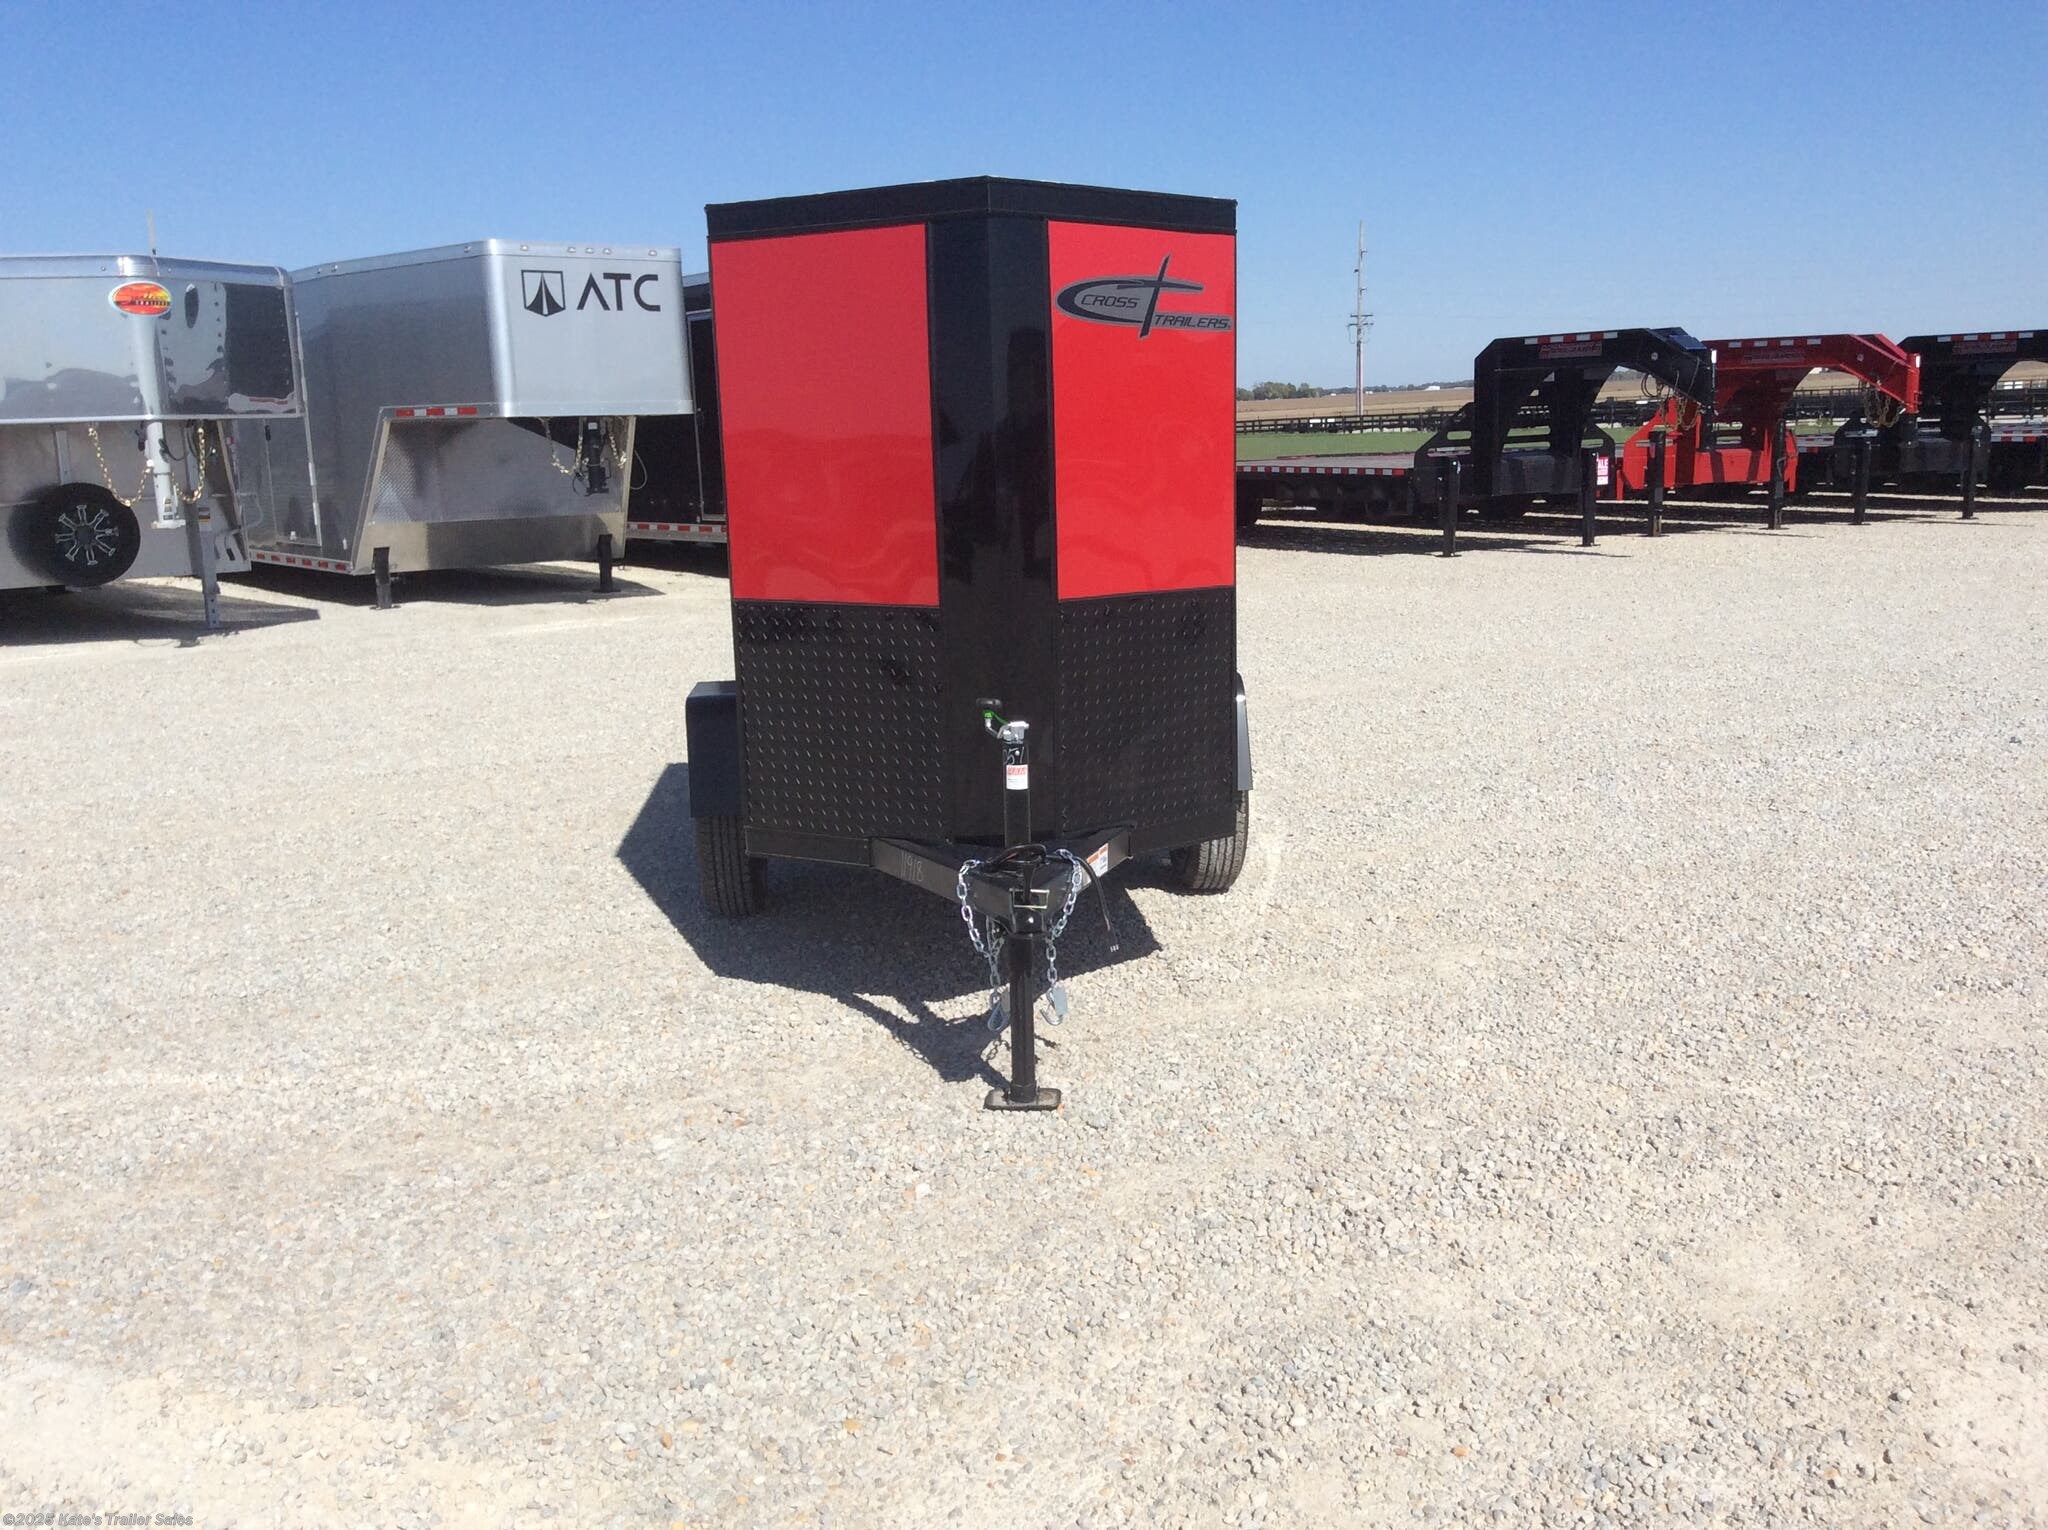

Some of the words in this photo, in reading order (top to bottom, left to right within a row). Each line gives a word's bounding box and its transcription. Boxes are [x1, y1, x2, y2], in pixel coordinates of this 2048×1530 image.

[576, 272, 661, 312] ATC
[1081, 294, 1141, 309] CROSS
[1154, 313, 1229, 329] TRAILERS
